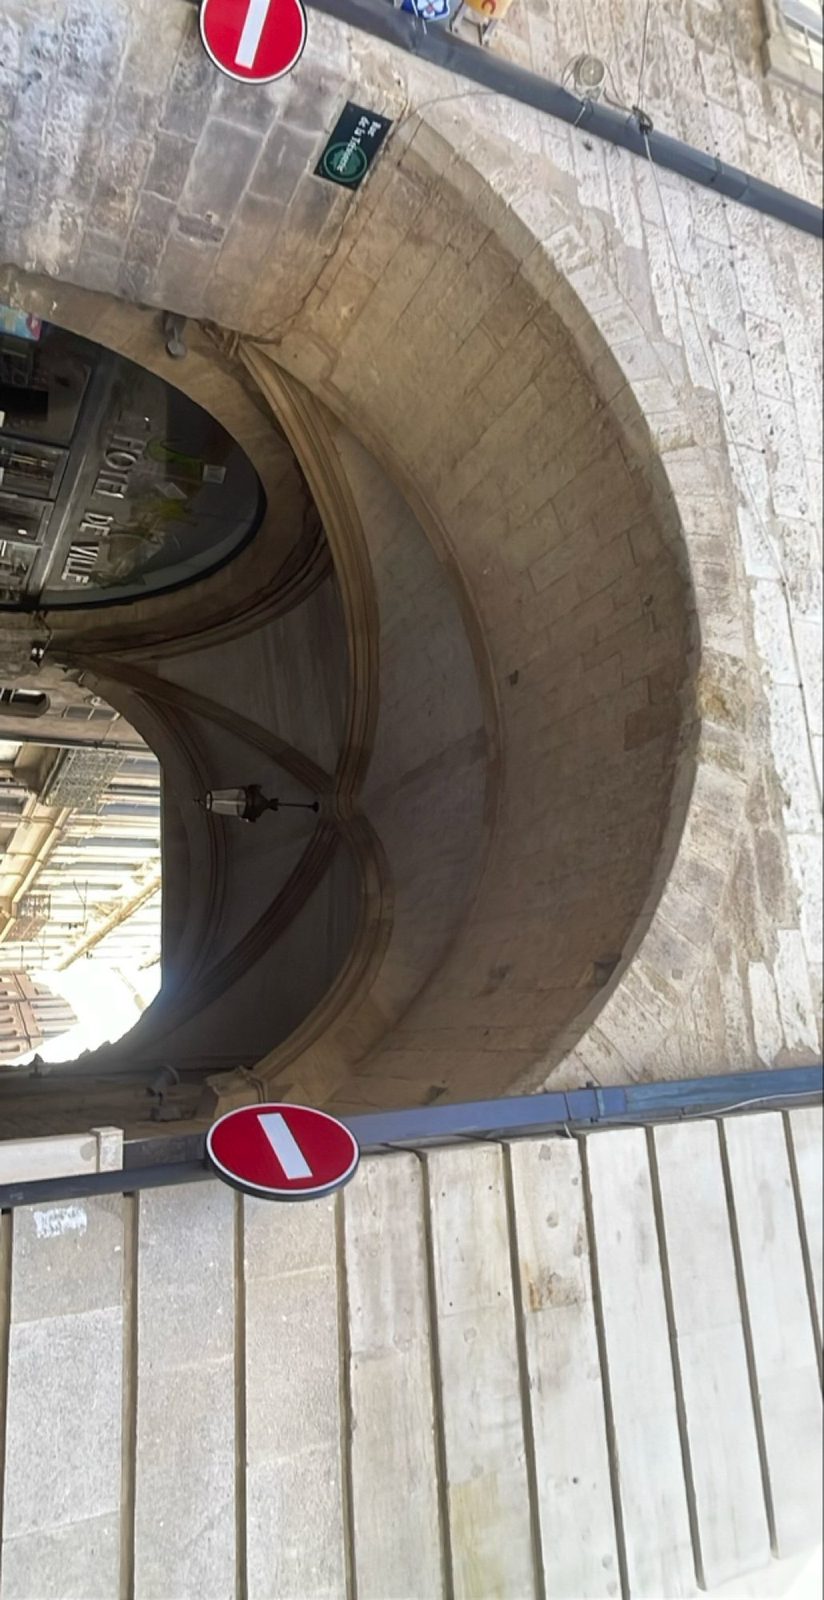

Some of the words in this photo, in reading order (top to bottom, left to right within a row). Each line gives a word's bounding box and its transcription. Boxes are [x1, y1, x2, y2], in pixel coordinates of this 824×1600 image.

[358, 116, 371, 128] de
[367, 121, 382, 138] Rue
[353, 127, 366, 137] la
[80, 511, 114, 537] DE
[61, 544, 100, 584] VILLE
